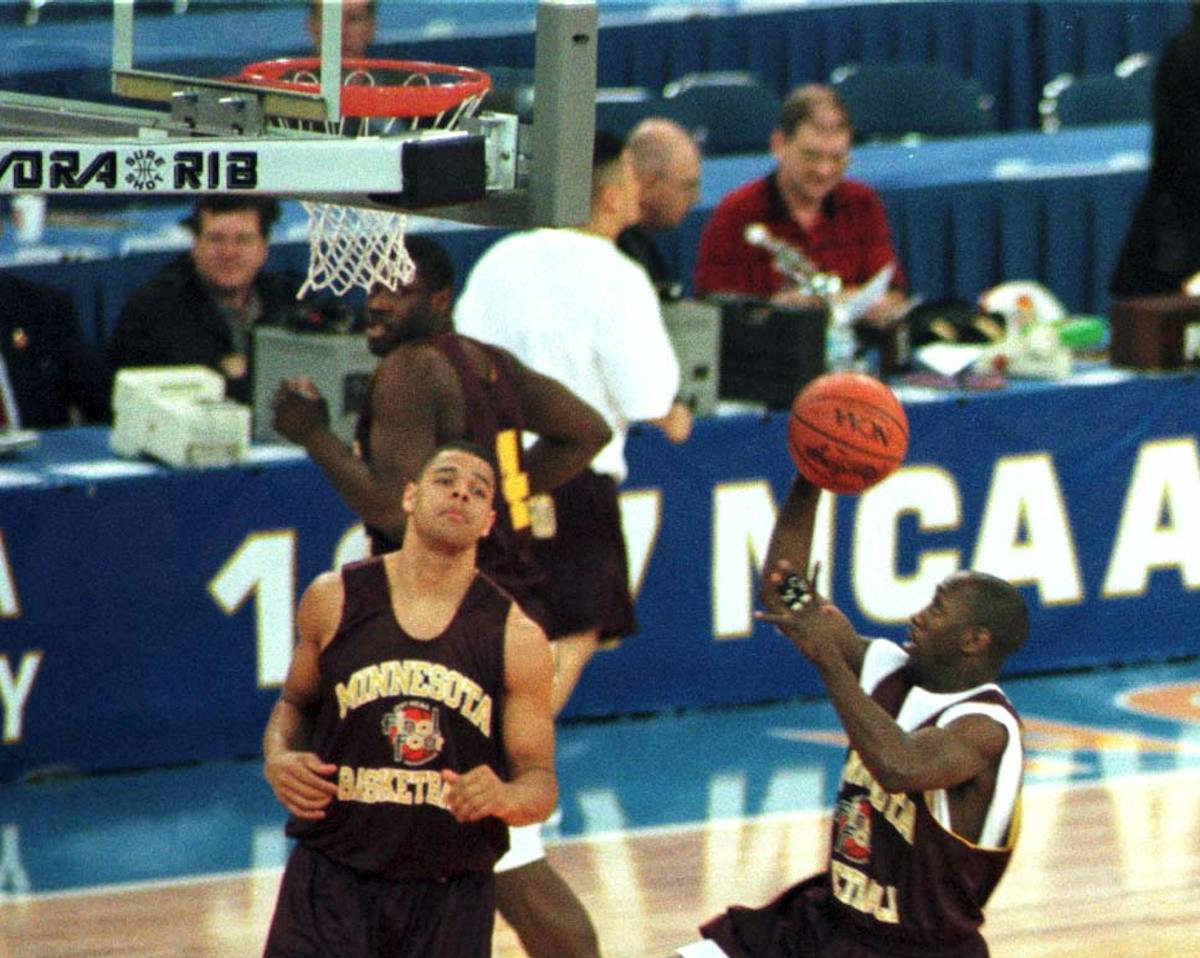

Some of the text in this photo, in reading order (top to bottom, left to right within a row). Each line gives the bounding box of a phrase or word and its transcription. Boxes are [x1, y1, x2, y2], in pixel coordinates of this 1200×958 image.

[125, 149, 167, 167] SURE
[173, 150, 258, 189] RIB
[125, 172, 165, 190] SHOT
[335, 659, 493, 738] MINNESOTA
